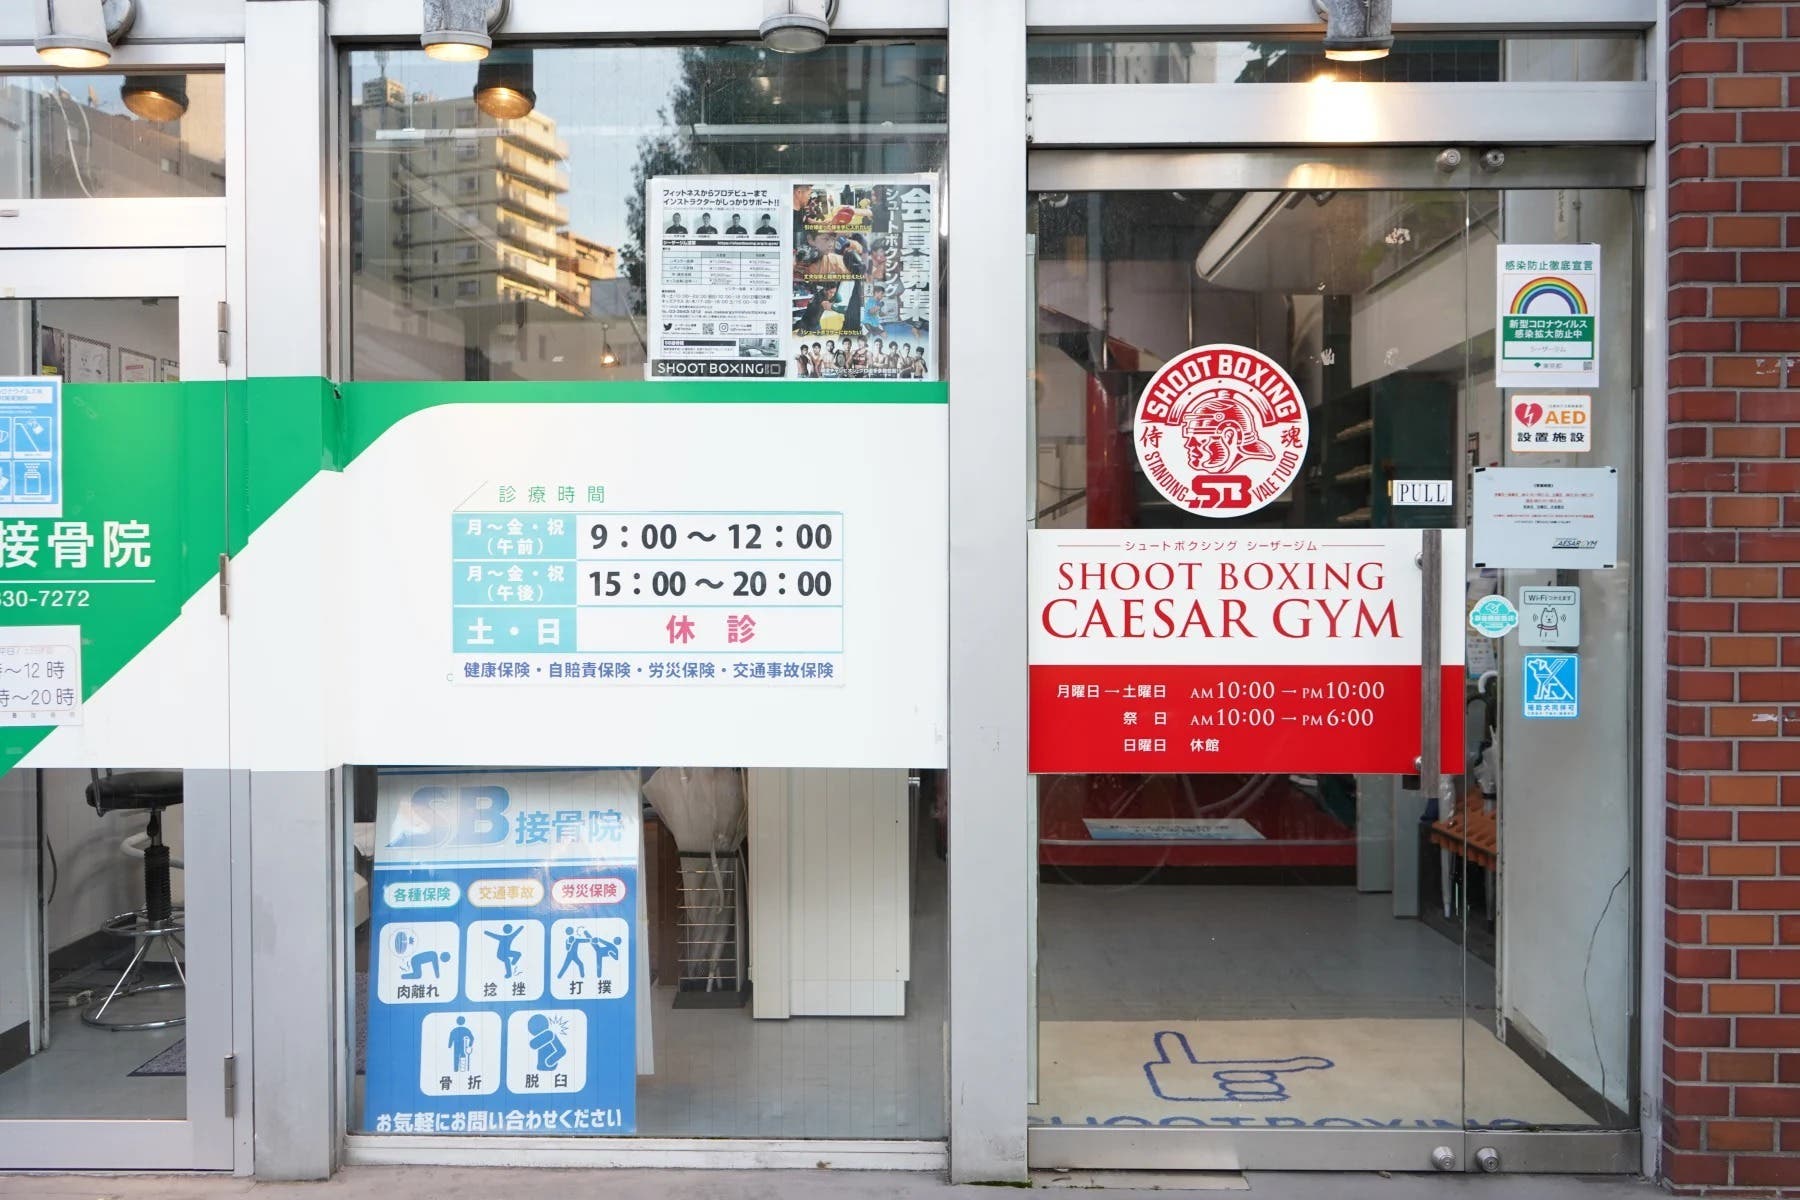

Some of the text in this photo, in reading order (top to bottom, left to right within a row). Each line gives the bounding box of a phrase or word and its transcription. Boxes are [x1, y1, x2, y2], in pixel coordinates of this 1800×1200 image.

[663, 189, 768, 197] フィットネスからプロデビューまで
[886, 189, 899, 297] シュートボクシング
[901, 187, 930, 321] 会員募集
[1505, 260, 1593, 271] 感染防止徹底宣言
[1509, 319, 1587, 329] 新型コロナウイルス
[1514, 329, 1582, 339] 感染拡大防止中
[658, 363, 764, 374] SHOOT BOXING
[1147, 354, 1297, 418] SHOOT BOXING
[1545, 411, 1586, 424] AED
[1140, 426, 1163, 448] 侍
[1280, 426, 1304, 449] 魂
[1517, 432, 1585, 443] 設置施設
[1144, 451, 1192, 502] STANDING
[1252, 450, 1299, 502] VALE TUDO
[499, 485, 606, 504] 診療時間
[1185, 475, 1252, 508] SB
[1400, 483, 1446, 502] PULL
[466, 517, 564, 537] 月～金・祝
[0, 520, 151, 569] 接骨院
[1124, 540, 1317, 551] シュートボクシング シーザージム
[466, 564, 564, 583] 月～金・祝
[1057, 561, 1386, 591] SHOOT BOXING
[0, 590, 90, 607] 30-7272
[1041, 598, 1404, 639] CAESAR GYM
[466, 614, 756, 645] 土・日 休診
[463, 661, 834, 679] 健康保険・自賠責保険・労災保険・交通事故保険
[1123, 738, 1220, 752] 日曜日 休館
[515, 808, 624, 845] 接骨院
[393, 887, 452, 902] 各種保険
[478, 886, 535, 900] 交通事故
[561, 883, 618, 898] 労災保険
[397, 985, 440, 999] 肉離れ
[483, 982, 527, 997] 捻挫
[569, 980, 612, 995] 打撲
[439, 1075, 483, 1090] 骨折
[525, 1073, 568, 1088] 脱臼
[376, 1108, 623, 1134] お気軽にお問い合わせください
